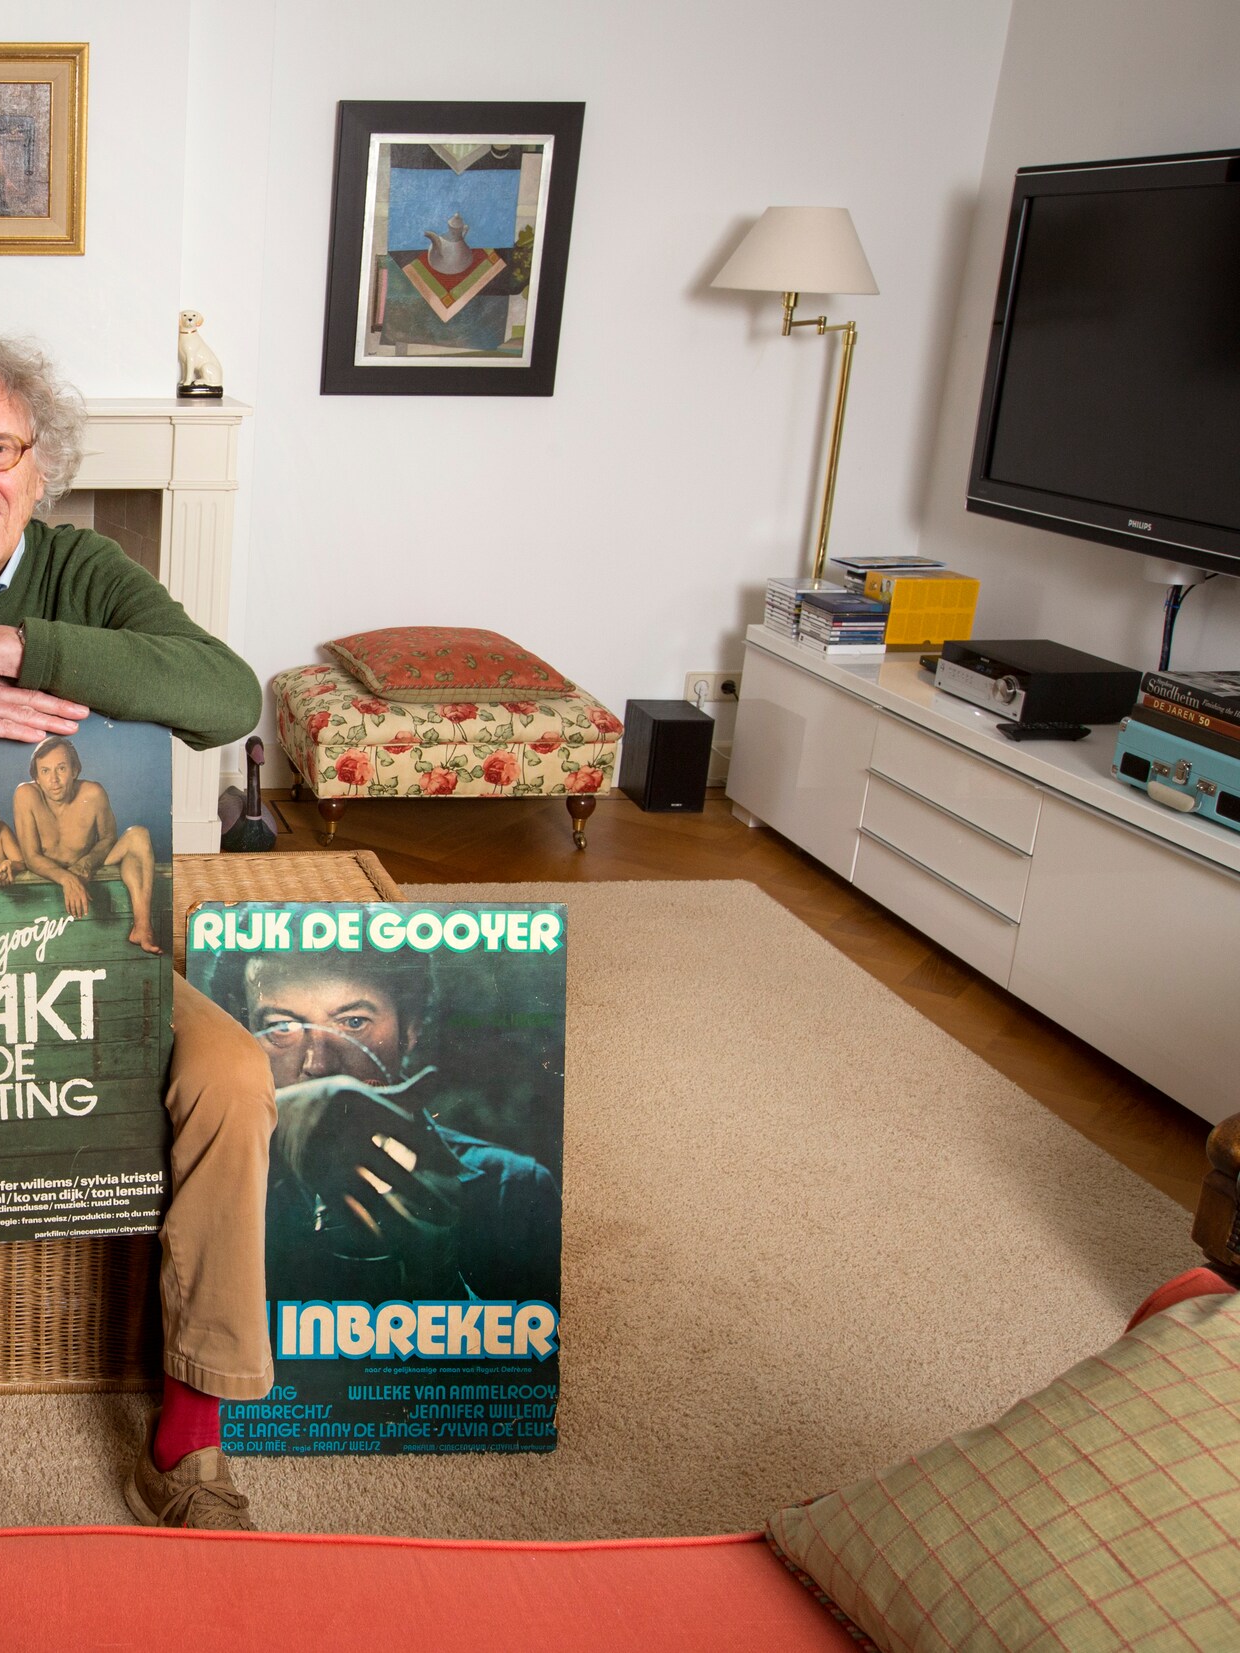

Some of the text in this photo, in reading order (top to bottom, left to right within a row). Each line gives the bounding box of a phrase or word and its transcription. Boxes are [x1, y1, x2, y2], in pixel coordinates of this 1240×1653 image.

[1128, 519, 1152, 531] PHILIPS
[1146, 678, 1200, 709] Sondheim
[1153, 700, 1166, 711] DE
[1167, 705, 1195, 721] JAREN
[190, 910, 563, 954] RIJK DE GOOYER
[20, 1178, 72, 1190] willems
[80, 1174, 118, 1188] sylvia
[121, 1171, 163, 1184] kristel
[13, 1192, 31, 1203] ko
[32, 1191, 57, 1201] van
[59, 1188, 84, 1202] dijk
[91, 1188, 114, 1199] ton
[116, 1184, 164, 1197] lensink
[91, 1198, 112, 1207] ruud
[113, 1198, 130, 1206] bos
[21, 1216, 43, 1224] frans
[115, 1210, 130, 1218] rob
[131, 1209, 142, 1217] du
[279, 1302, 557, 1359] INBREKER
[348, 1385, 556, 1400] WILLEKE VAN AMMELROOY
[228, 1404, 333, 1419] LAMBRECHTS
[410, 1404, 557, 1419] JENNIFER WILLEMS
[223, 1422, 556, 1438] DE LANGE ANNY DE LANGE SYLVIA DE LEUR
[221, 1441, 244, 1452] ROB
[246, 1441, 262, 1452] DU
[313, 1441, 347, 1451] FRANS
[349, 1441, 381, 1451] WEISZ
